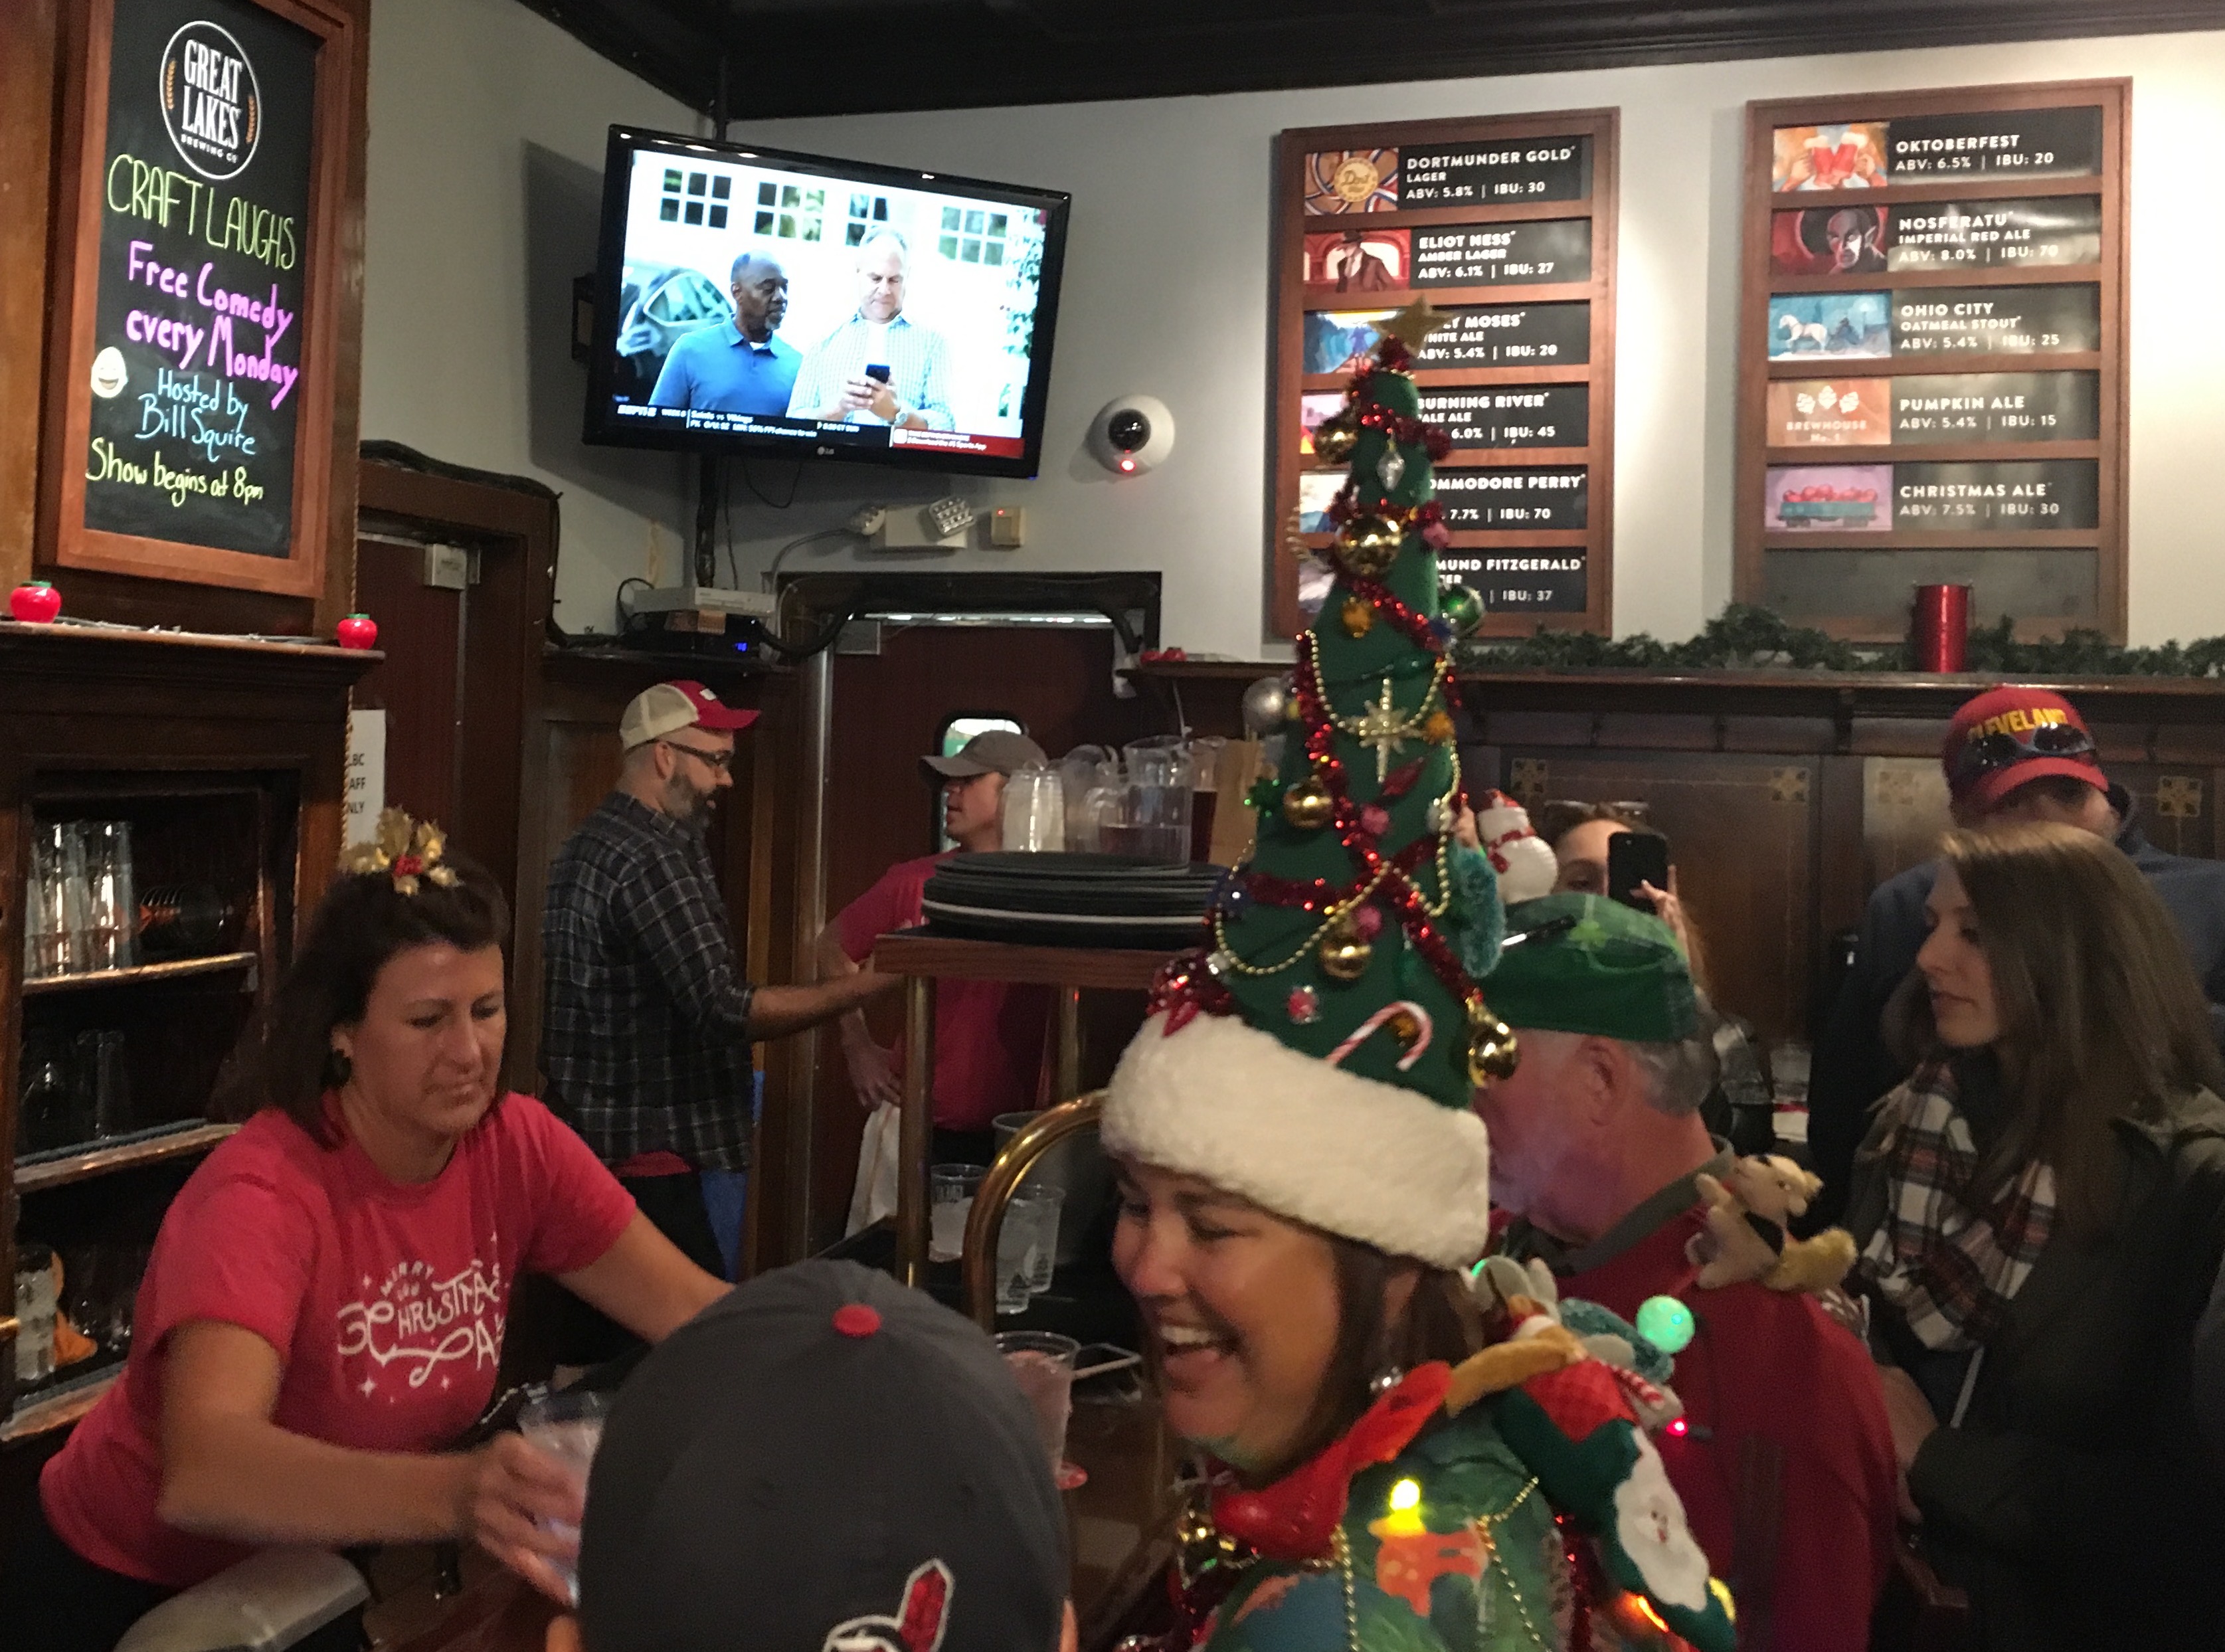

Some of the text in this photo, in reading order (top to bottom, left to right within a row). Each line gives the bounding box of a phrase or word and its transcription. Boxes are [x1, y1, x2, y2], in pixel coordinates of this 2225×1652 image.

[184, 39, 242, 104] GREAT
[182, 85, 242, 149] LAKES
[181, 134, 224, 157] BREWING
[1896, 135, 2020, 153] OKTOBERFEST
[1407, 147, 1571, 169] DORTMUNDER GOLD
[1896, 152, 2054, 171] ABV: 6.5% IBU: 20
[1407, 172, 1447, 183] LAGER
[1407, 181, 1546, 199] ABV: 5.8% IBU: 30
[108, 154, 296, 270] CRAFT LAUGHS
[1899, 214, 2006, 230] NOSFERATU
[1419, 233, 1512, 250] ELIOT NESS
[1899, 229, 2030, 244] IMPERIAL RED ALE
[1418, 248, 1506, 262] AMBER LAGER
[1899, 245, 2058, 263] ABV: 8.0% IBU: 70
[1418, 262, 1554, 279] ABV: 6.1% IBU: 27
[128, 240, 294, 347] Free Comedy
[1901, 303, 1993, 317] OHIO CITY
[1465, 315, 1520, 329] MOSES
[1901, 318, 2016, 331] OATMEAL STOUT
[1460, 331, 1484, 341] ALE
[1901, 334, 2060, 350] ABV: 5.4% IBU: 25
[1417, 344, 1558, 359] ABV: 5.4% IBU: 20
[126, 310, 298, 411] every Monday
[158, 367, 249, 433] Hosted by
[1417, 394, 1545, 409] BURNING RIVER
[1900, 396, 2025, 411] PUMPKIN ALE
[691, 410, 715, 420] Saints
[727, 413, 753, 424] Vikings
[1448, 412, 1472, 422] ALE
[1900, 414, 2056, 430] ABV: 5.4% IBU: 15
[135, 393, 256, 462] Bill Squire
[1451, 426, 1556, 439] 6.0% IBU: 45
[1786, 420, 1866, 430] BREWHOUSE
[85, 437, 264, 507] Show begins at 8pm
[1430, 476, 1581, 490] OMMODORE PERRY
[1900, 483, 2046, 498] CHRISTMAS ALE
[1450, 508, 1551, 520] 7.7% IBU: 70
[1900, 502, 2059, 515] ABV: 7.5% IBU: 30
[1436, 559, 1581, 571] MUND FITZGERALD
[1502, 590, 1552, 601] IBU: 37
[348, 801, 365, 814] NLY
